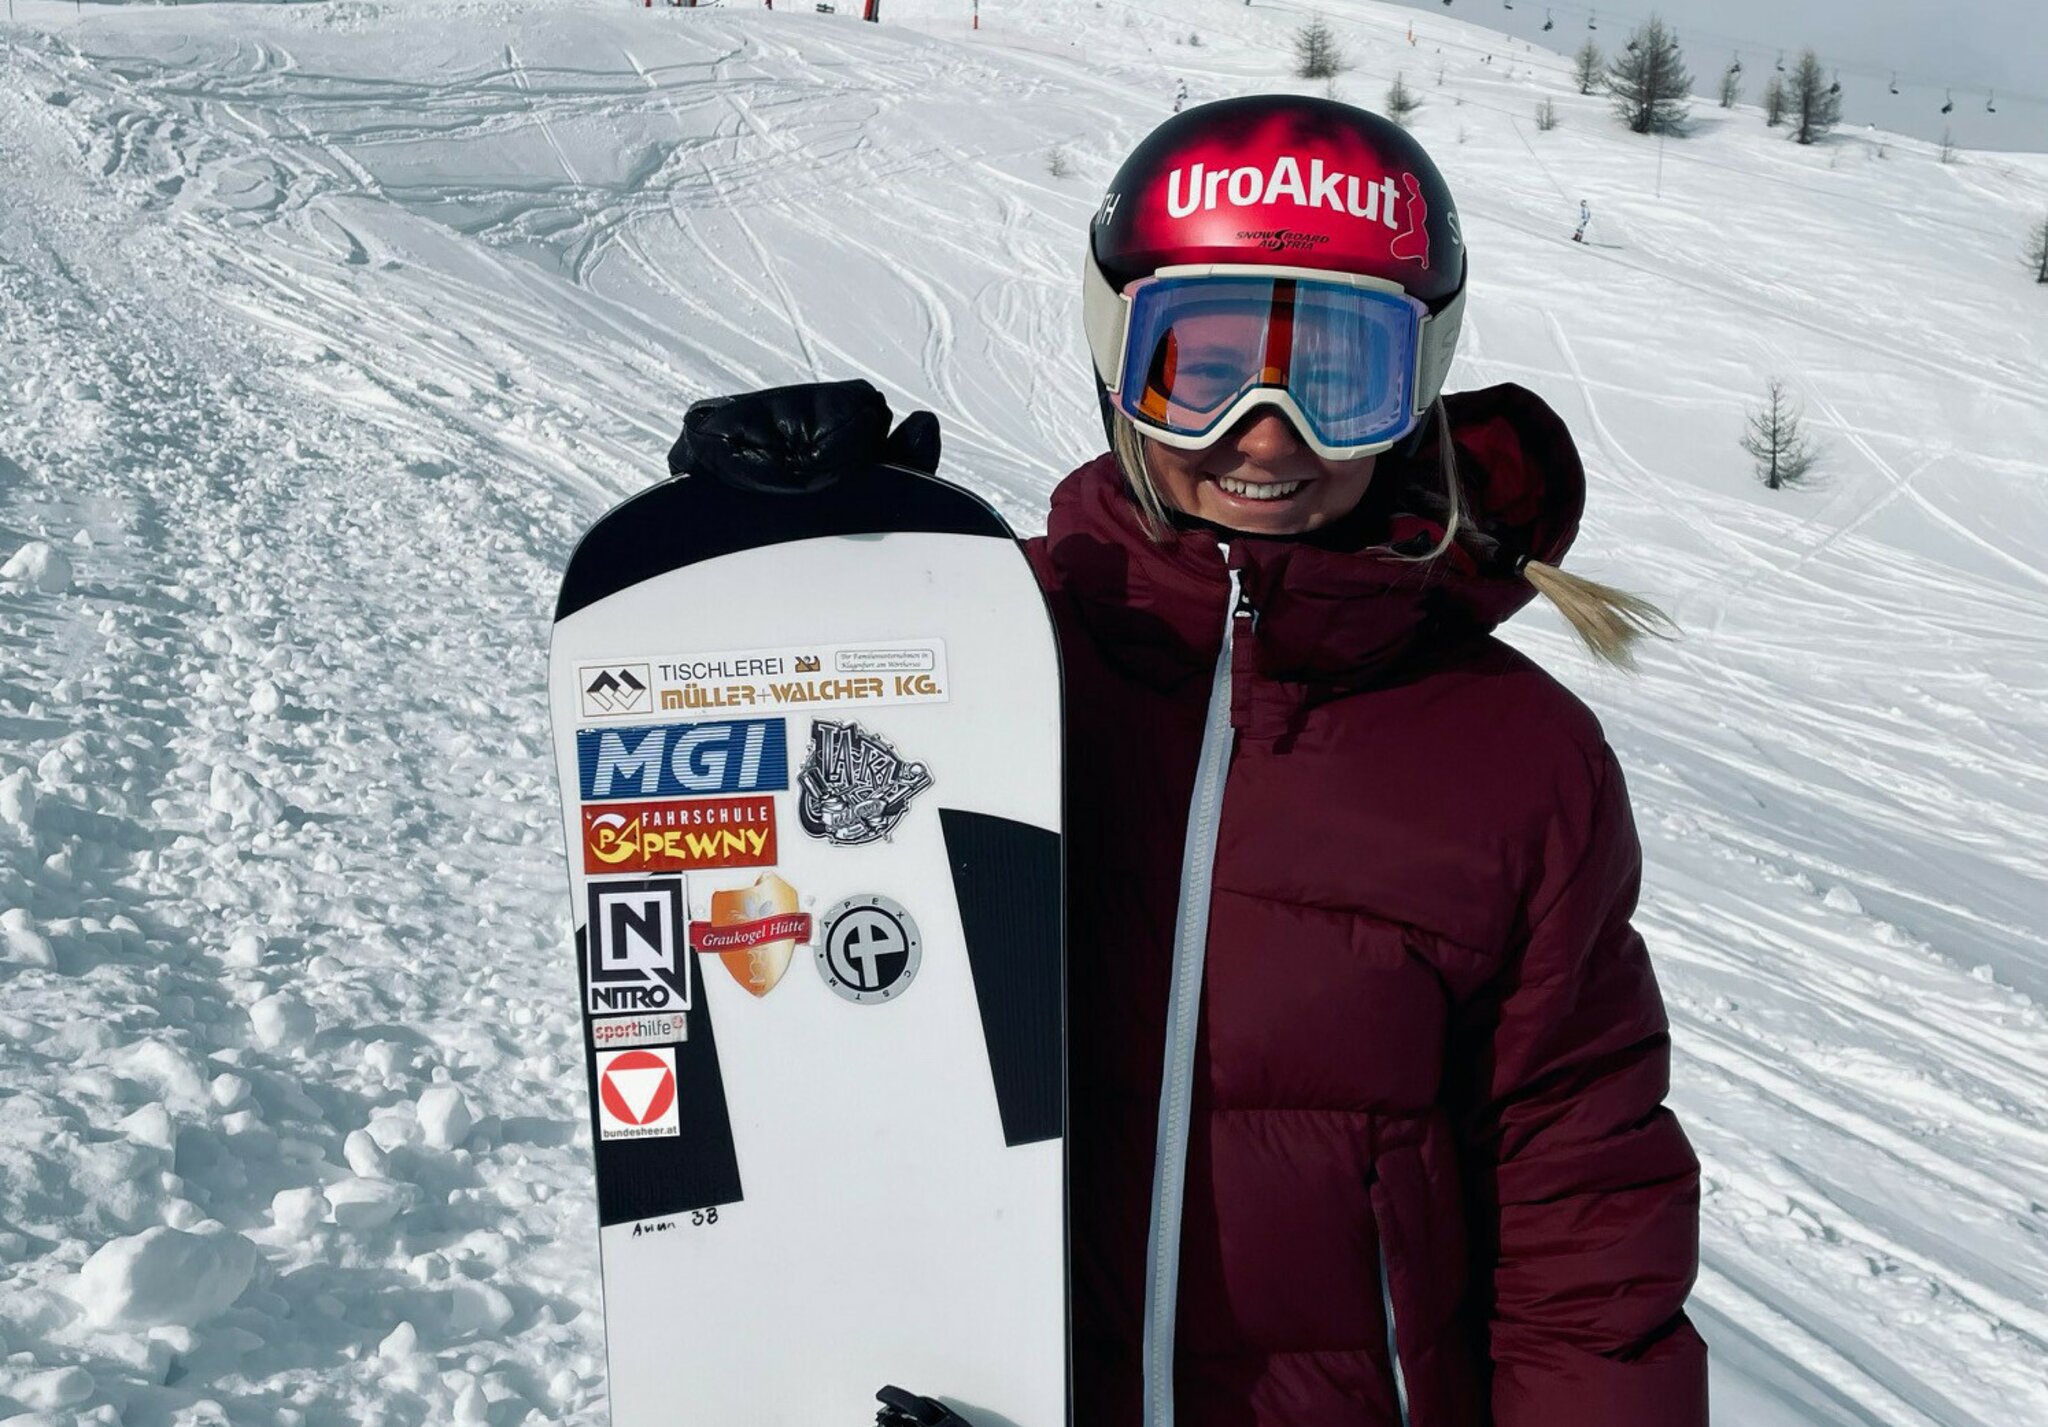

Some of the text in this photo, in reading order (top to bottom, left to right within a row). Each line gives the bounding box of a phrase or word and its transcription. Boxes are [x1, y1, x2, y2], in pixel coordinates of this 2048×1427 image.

[1167, 156, 1400, 230] UroAkut
[659, 658, 784, 681] TISCHLEREI
[895, 675, 942, 696] KG.
[592, 724, 766, 796] MGI
[642, 806, 768, 827] FAHRSCHULE
[643, 828, 768, 862] PEWNY
[702, 921, 805, 946] Graukogel Hütte
[592, 985, 670, 1011] NITRO
[595, 1020, 671, 1042] sporthilfe
[603, 1126, 677, 1138] bundesheer.at
